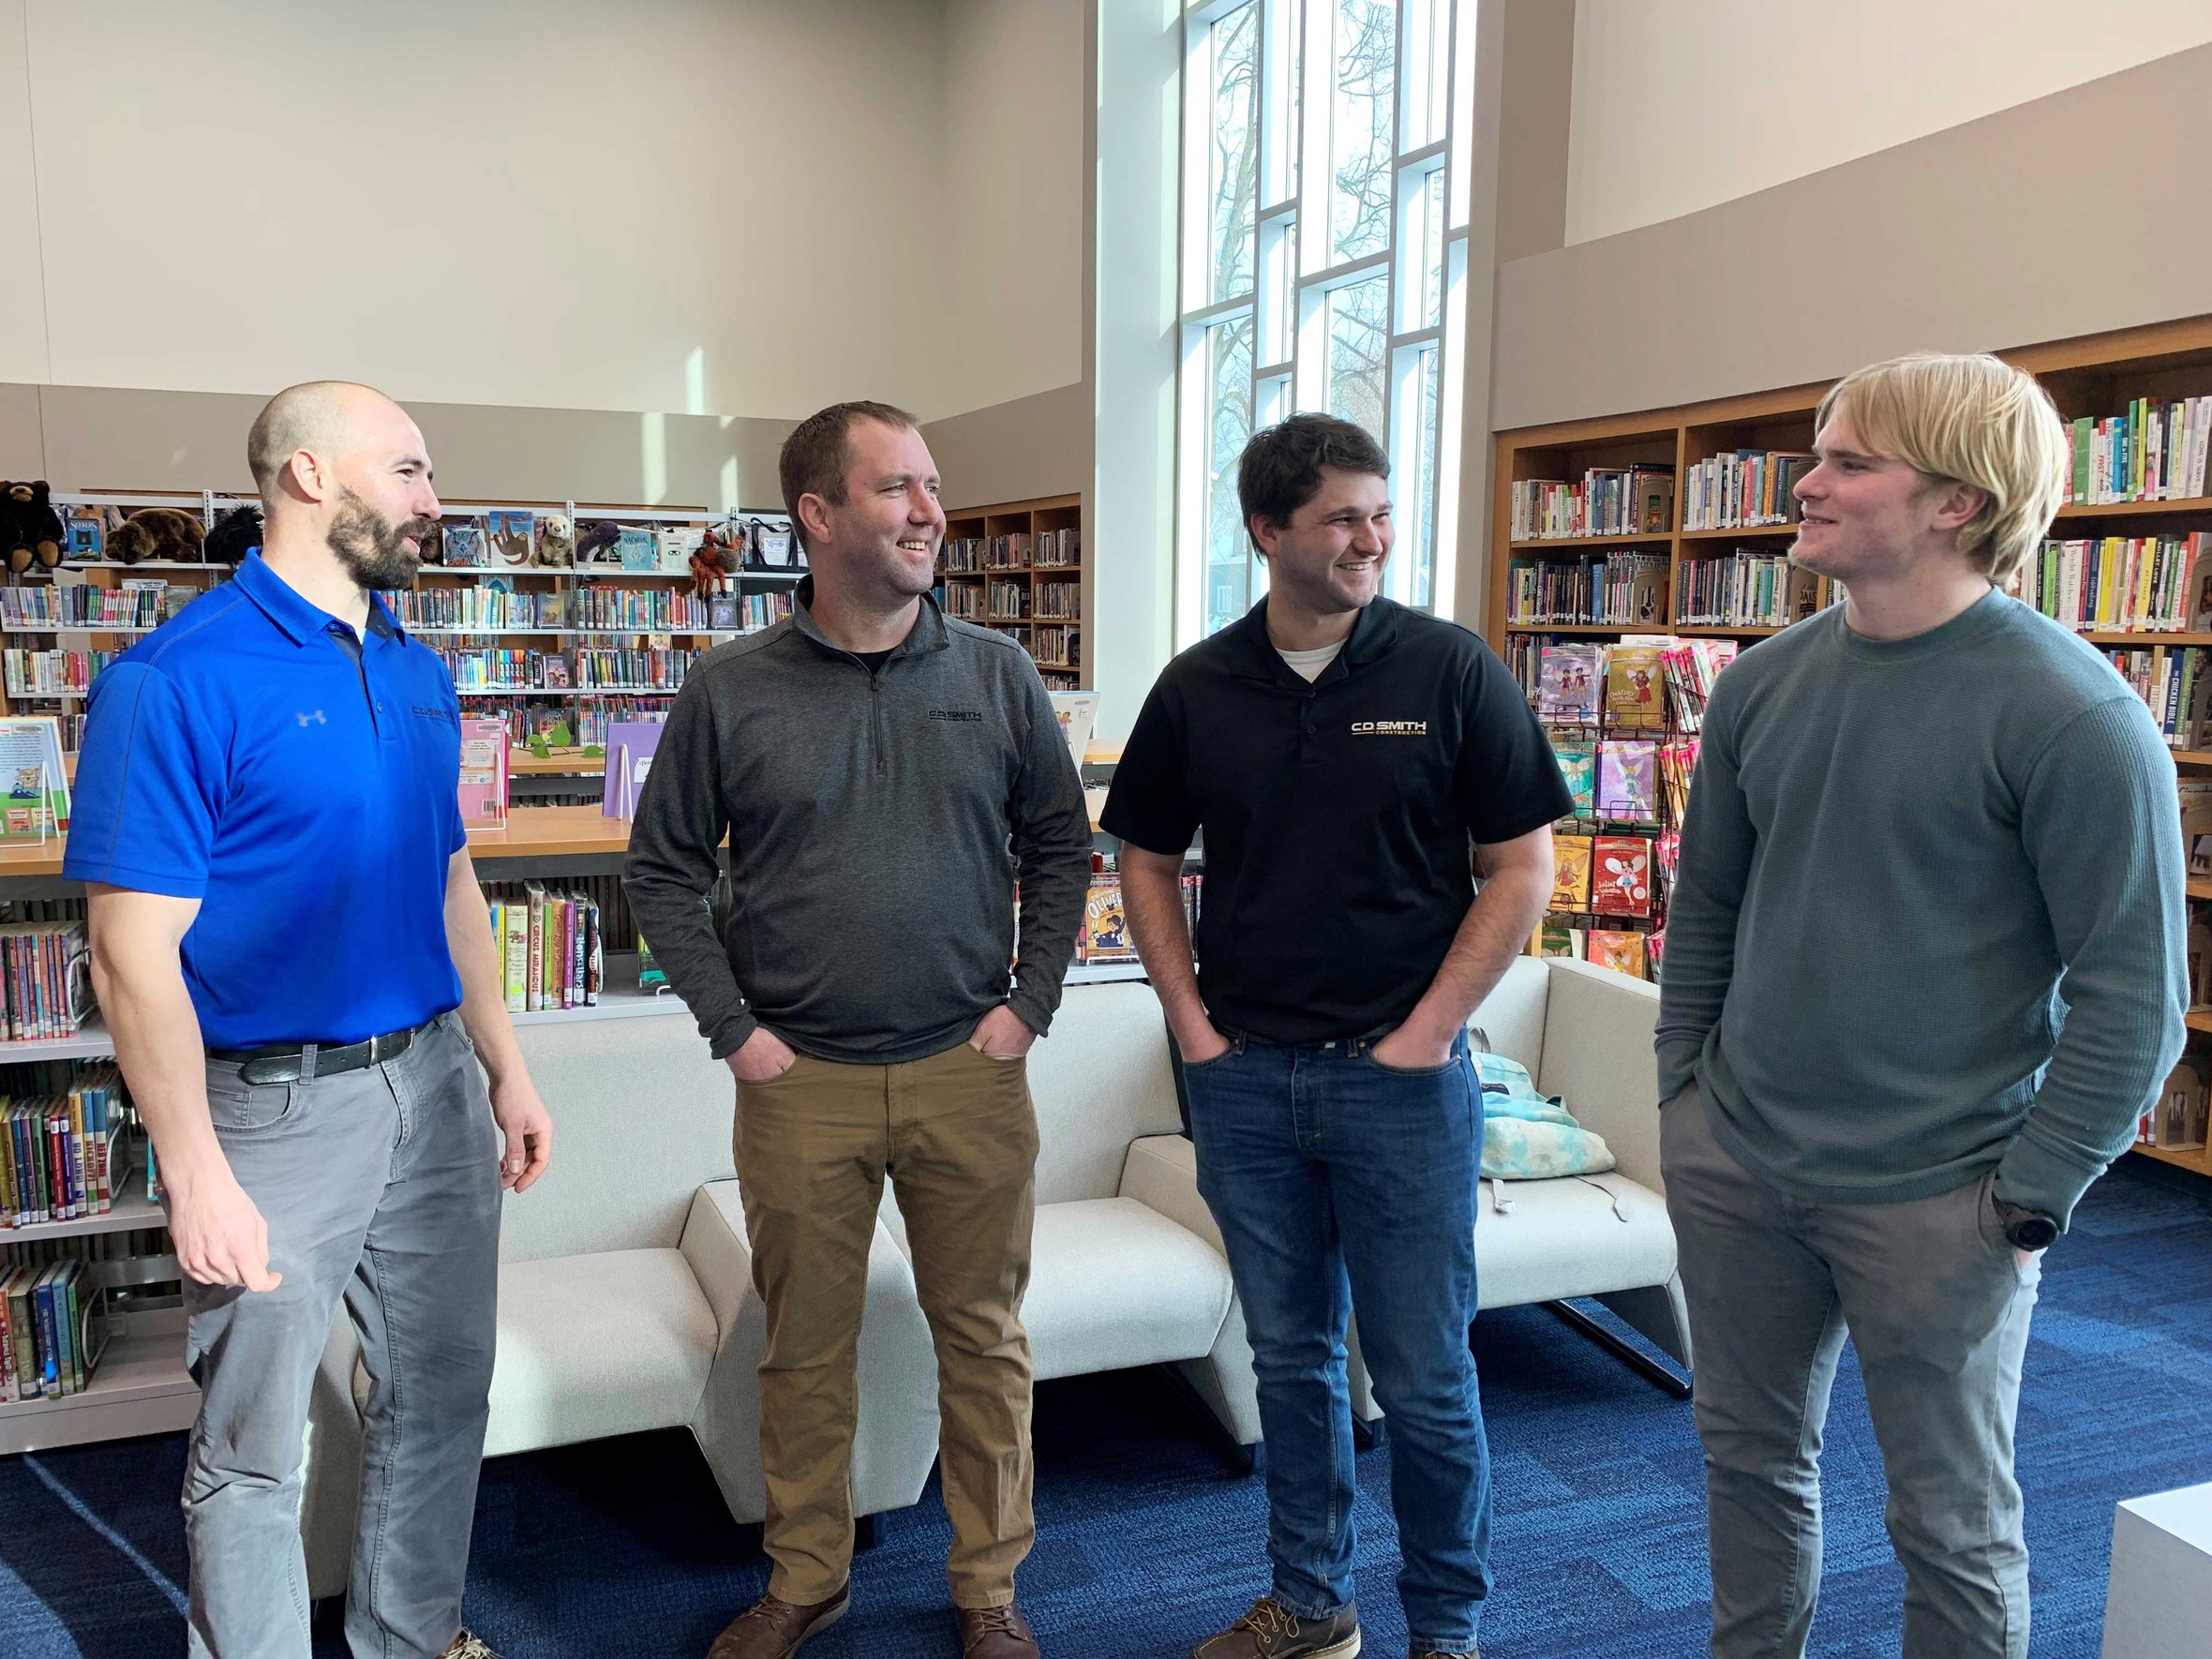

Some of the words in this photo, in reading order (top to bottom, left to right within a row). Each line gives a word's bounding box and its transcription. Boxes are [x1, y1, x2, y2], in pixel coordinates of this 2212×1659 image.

[2170, 678, 2179, 705] CHICKEN
[2167, 706, 2176, 725] BIBLE
[1376, 721, 1427, 731] SMITH
